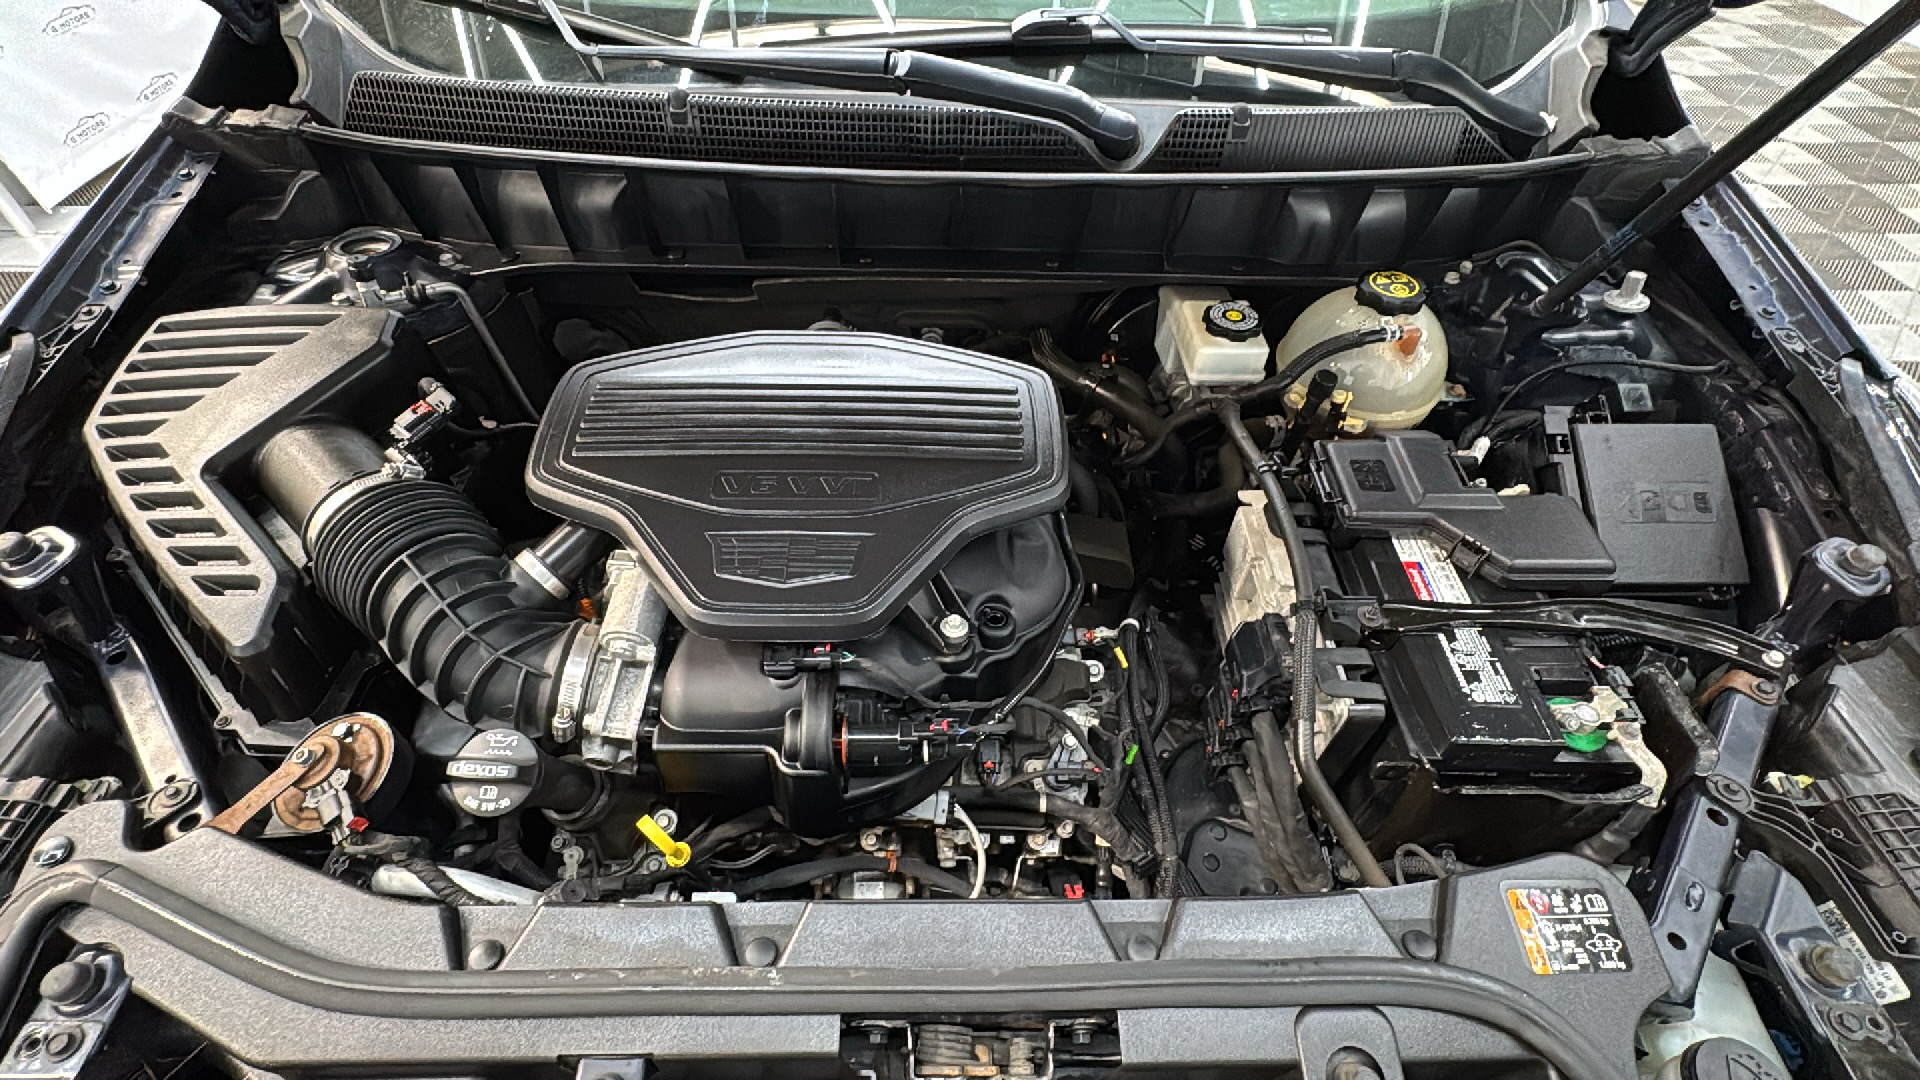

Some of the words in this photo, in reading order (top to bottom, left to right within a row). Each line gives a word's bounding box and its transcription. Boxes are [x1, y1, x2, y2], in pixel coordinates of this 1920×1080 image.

[59, 11, 91, 31] MOTORS
[150, 79, 174, 96] MOTORS
[76, 119, 105, 140] MOTORS
[452, 761, 511, 776] dexos
[464, 796, 479, 809] SAE
[481, 798, 510, 811] 5W-30
